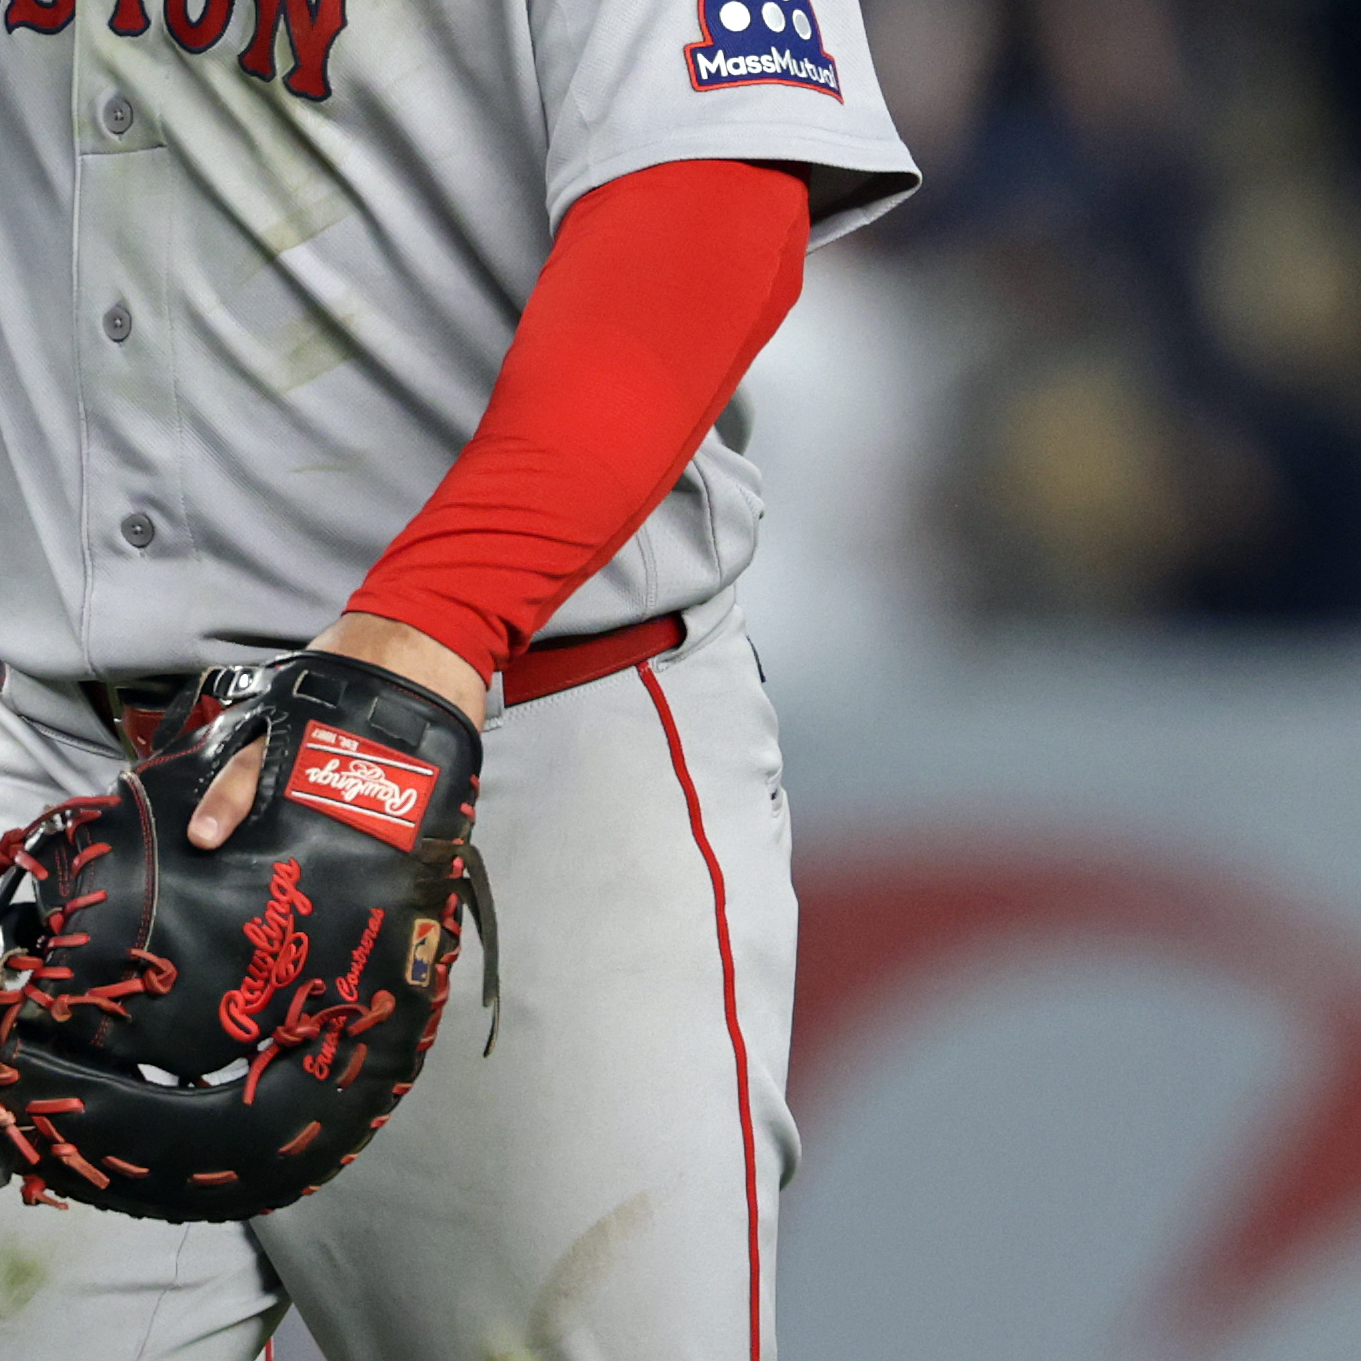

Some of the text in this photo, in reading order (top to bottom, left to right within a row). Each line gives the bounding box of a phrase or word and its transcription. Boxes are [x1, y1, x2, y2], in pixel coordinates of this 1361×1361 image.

[696, 45, 838, 89] MassMutual
[305, 758, 418, 816] Rawlings
[219, 857, 314, 1042] Rawlings
